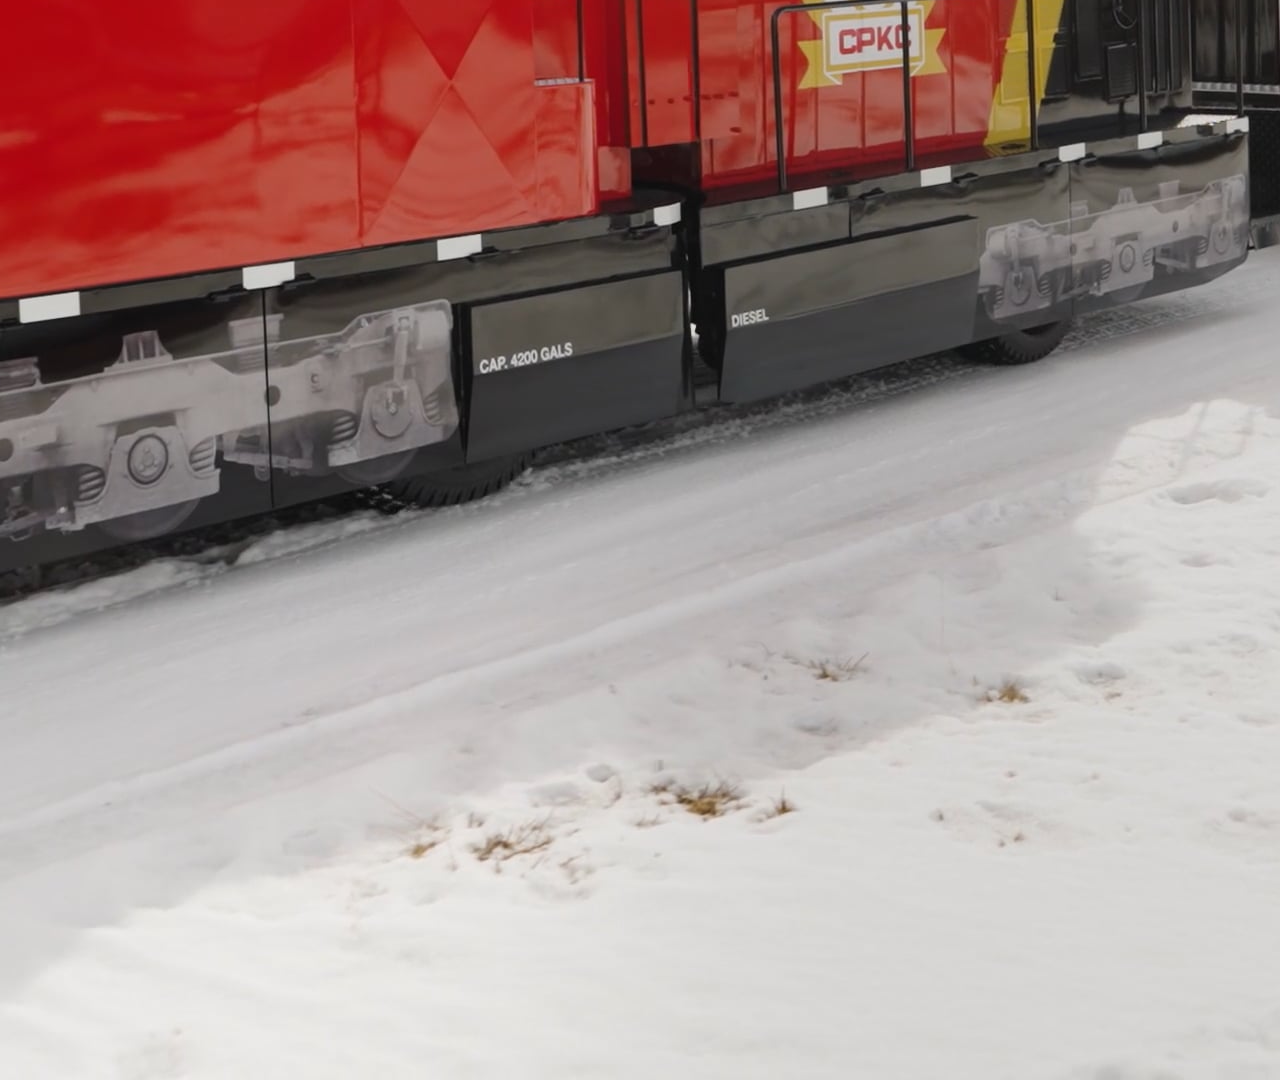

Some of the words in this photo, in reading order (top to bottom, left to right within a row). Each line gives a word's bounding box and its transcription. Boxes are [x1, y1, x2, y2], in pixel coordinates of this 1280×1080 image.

[838, 24, 912, 55] CPKC
[731, 308, 770, 328] DIESEL
[479, 358, 508, 374] CAP.
[510, 349, 538, 367] 4200
[540, 342, 573, 362] GALS
